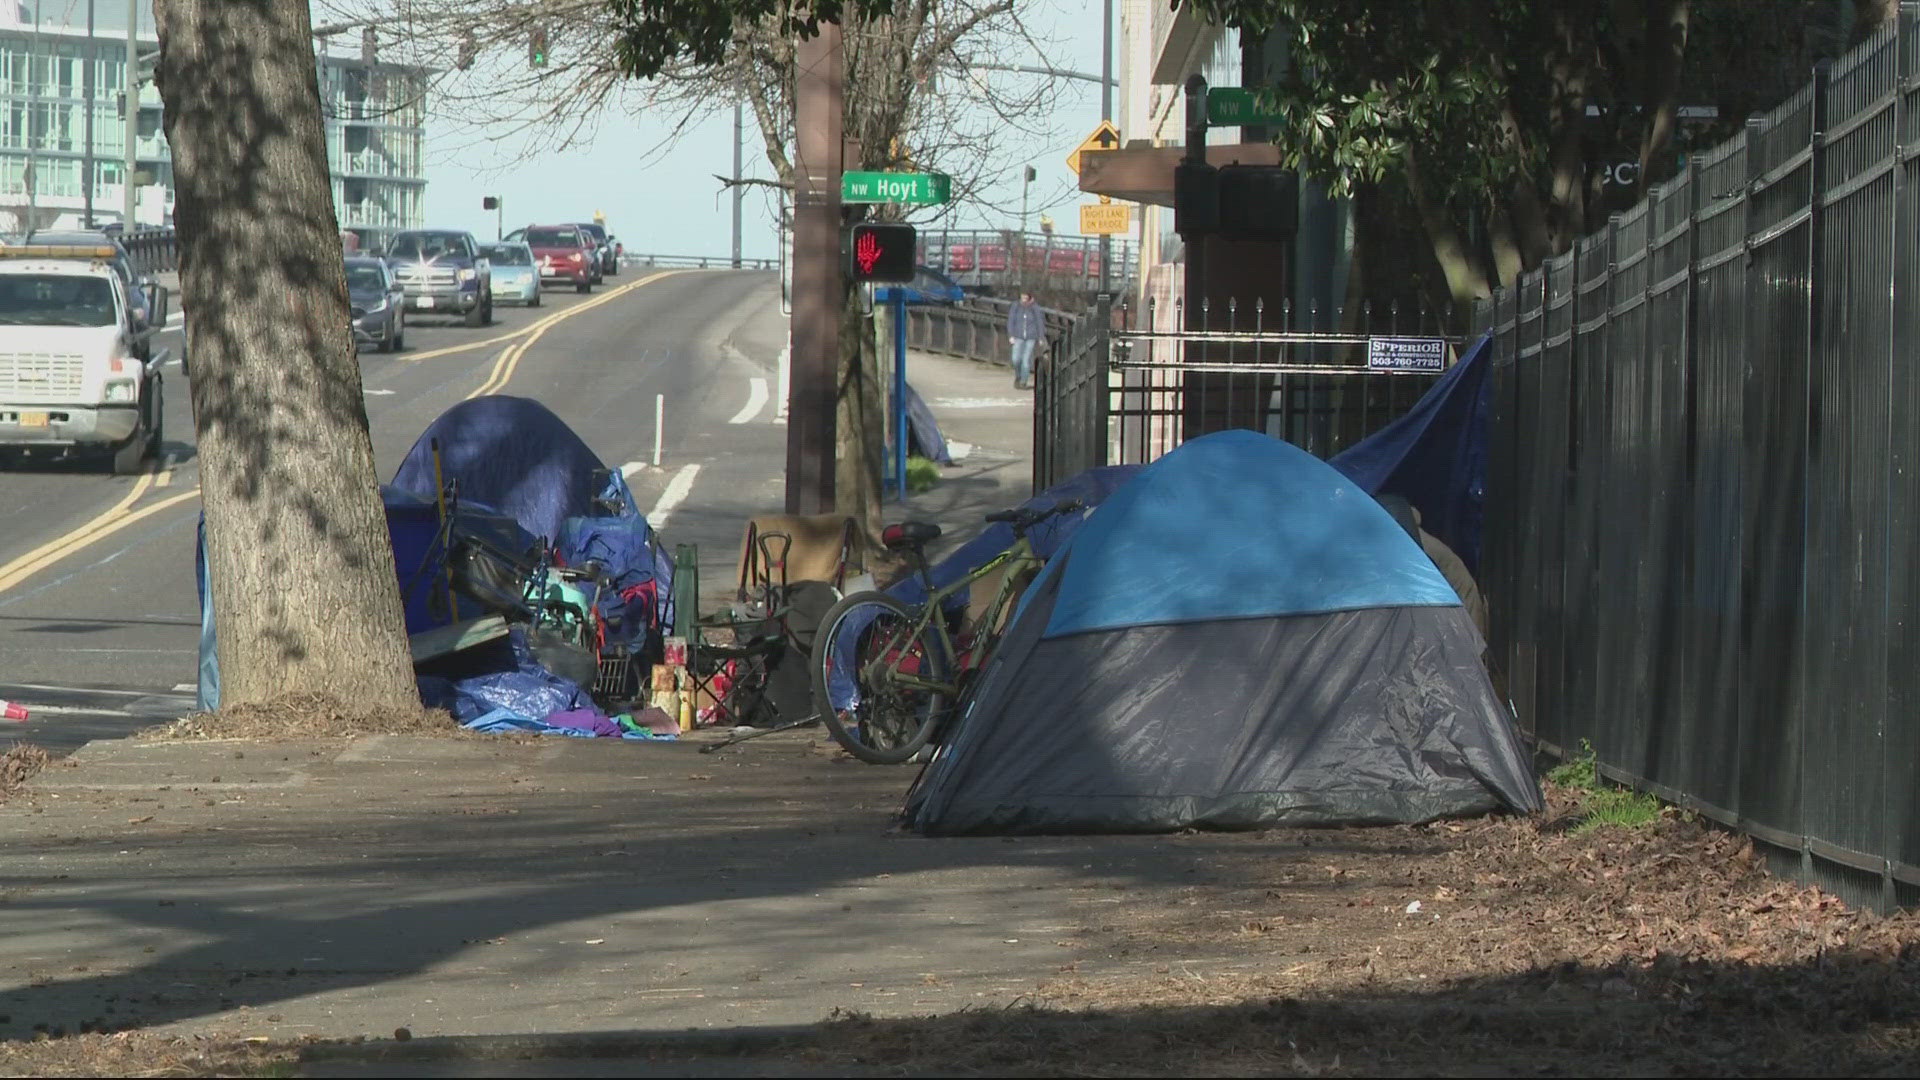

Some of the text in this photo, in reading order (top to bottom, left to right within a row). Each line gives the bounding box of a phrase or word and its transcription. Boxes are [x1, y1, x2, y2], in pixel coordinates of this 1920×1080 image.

[1219, 101, 1240, 116] NW
[851, 179, 918, 201] NW Hoyt
[1085, 209, 1125, 219] RIGHT LANE
[1086, 220, 1123, 229] ON BRIDGE
[1372, 341, 1441, 353] SUPERIOR
[1372, 357, 1441, 367] 503-760-7725
